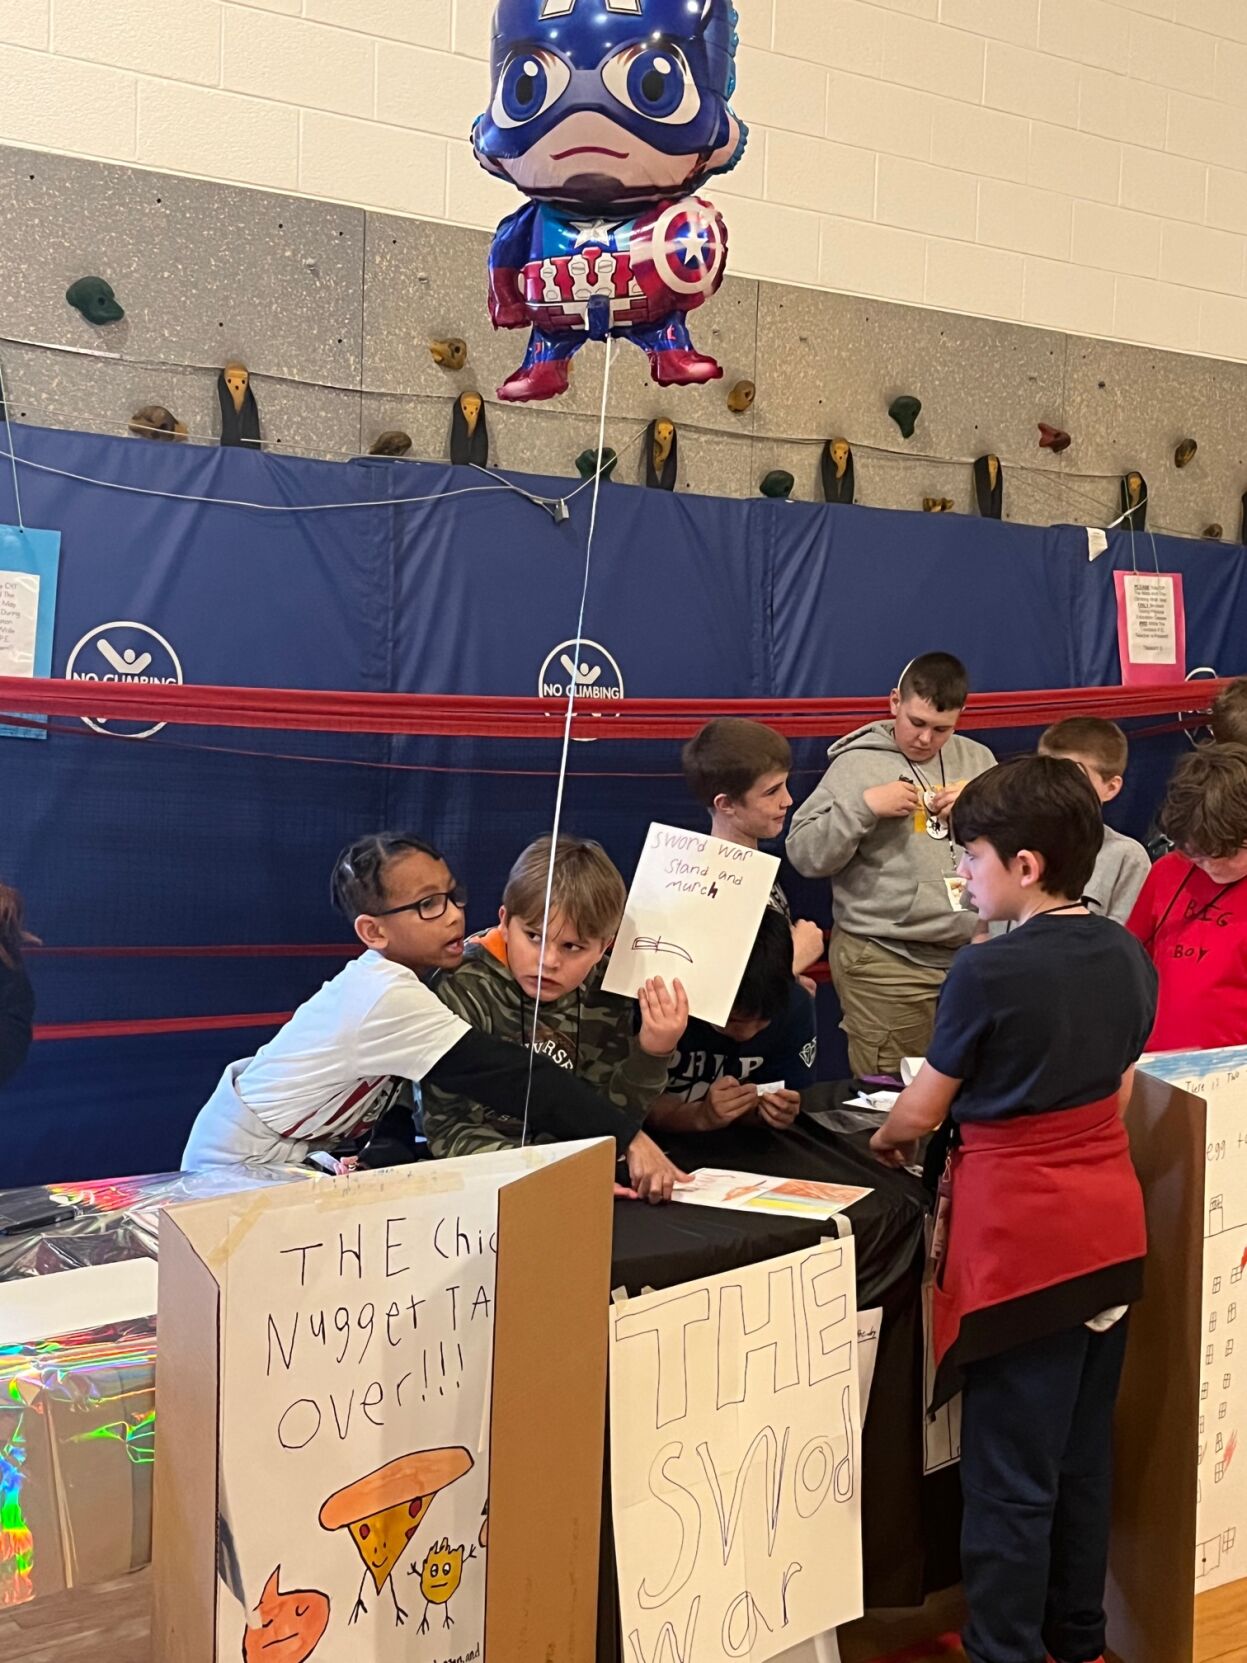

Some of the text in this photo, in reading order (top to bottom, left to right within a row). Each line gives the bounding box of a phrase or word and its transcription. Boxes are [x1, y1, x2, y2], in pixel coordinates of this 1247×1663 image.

[543, 683, 620, 700] NO CLIMBING
[718, 870, 744, 886] and
[1206, 1139, 1226, 1162] egg
[280, 1216, 411, 1287] THE
[266, 1294, 427, 1377] Nugget
[615, 1247, 852, 1430] THE
